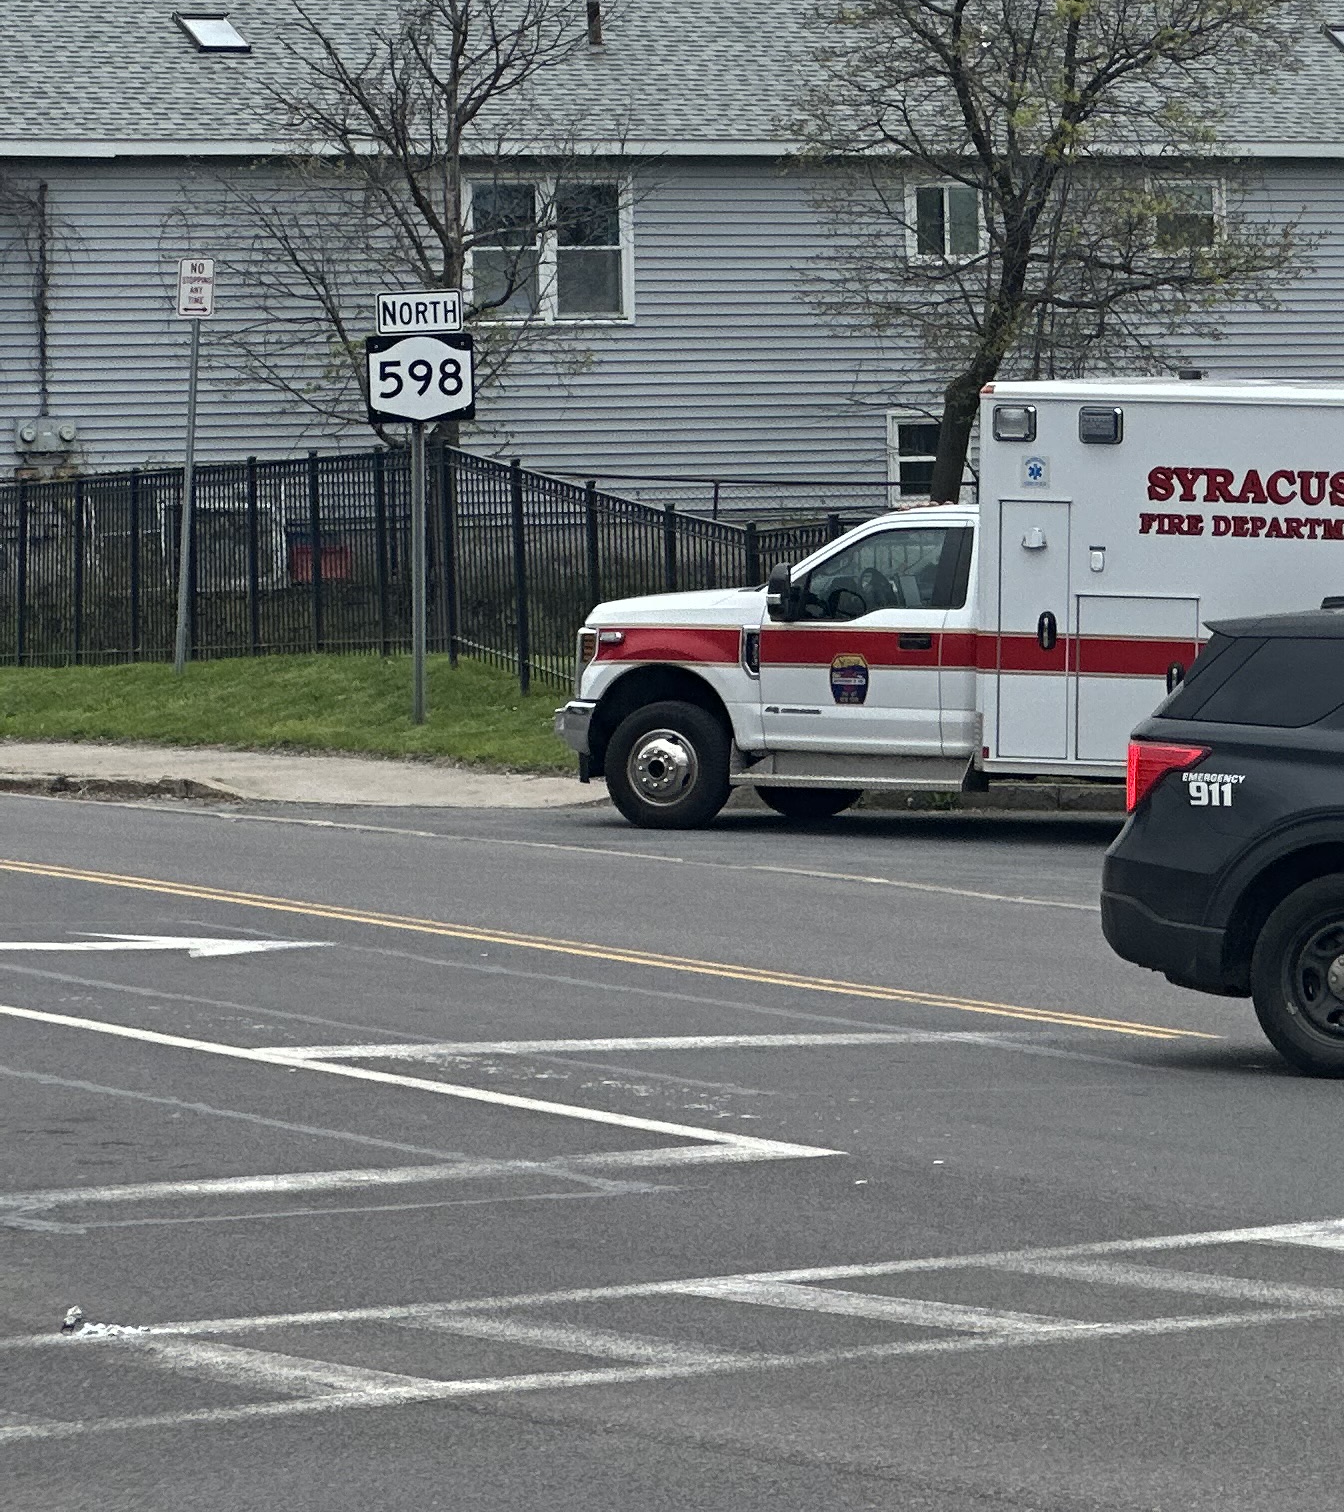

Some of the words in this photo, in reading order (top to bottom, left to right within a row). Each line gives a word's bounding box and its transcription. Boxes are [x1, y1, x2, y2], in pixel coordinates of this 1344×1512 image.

[190, 262, 205, 274] NO
[382, 300, 457, 326] NORTH
[379, 358, 463, 399] 598
[1139, 513, 1204, 535] FIRE
[1182, 772, 1246, 784] EMERGENCY
[1189, 782, 1232, 806] 911
